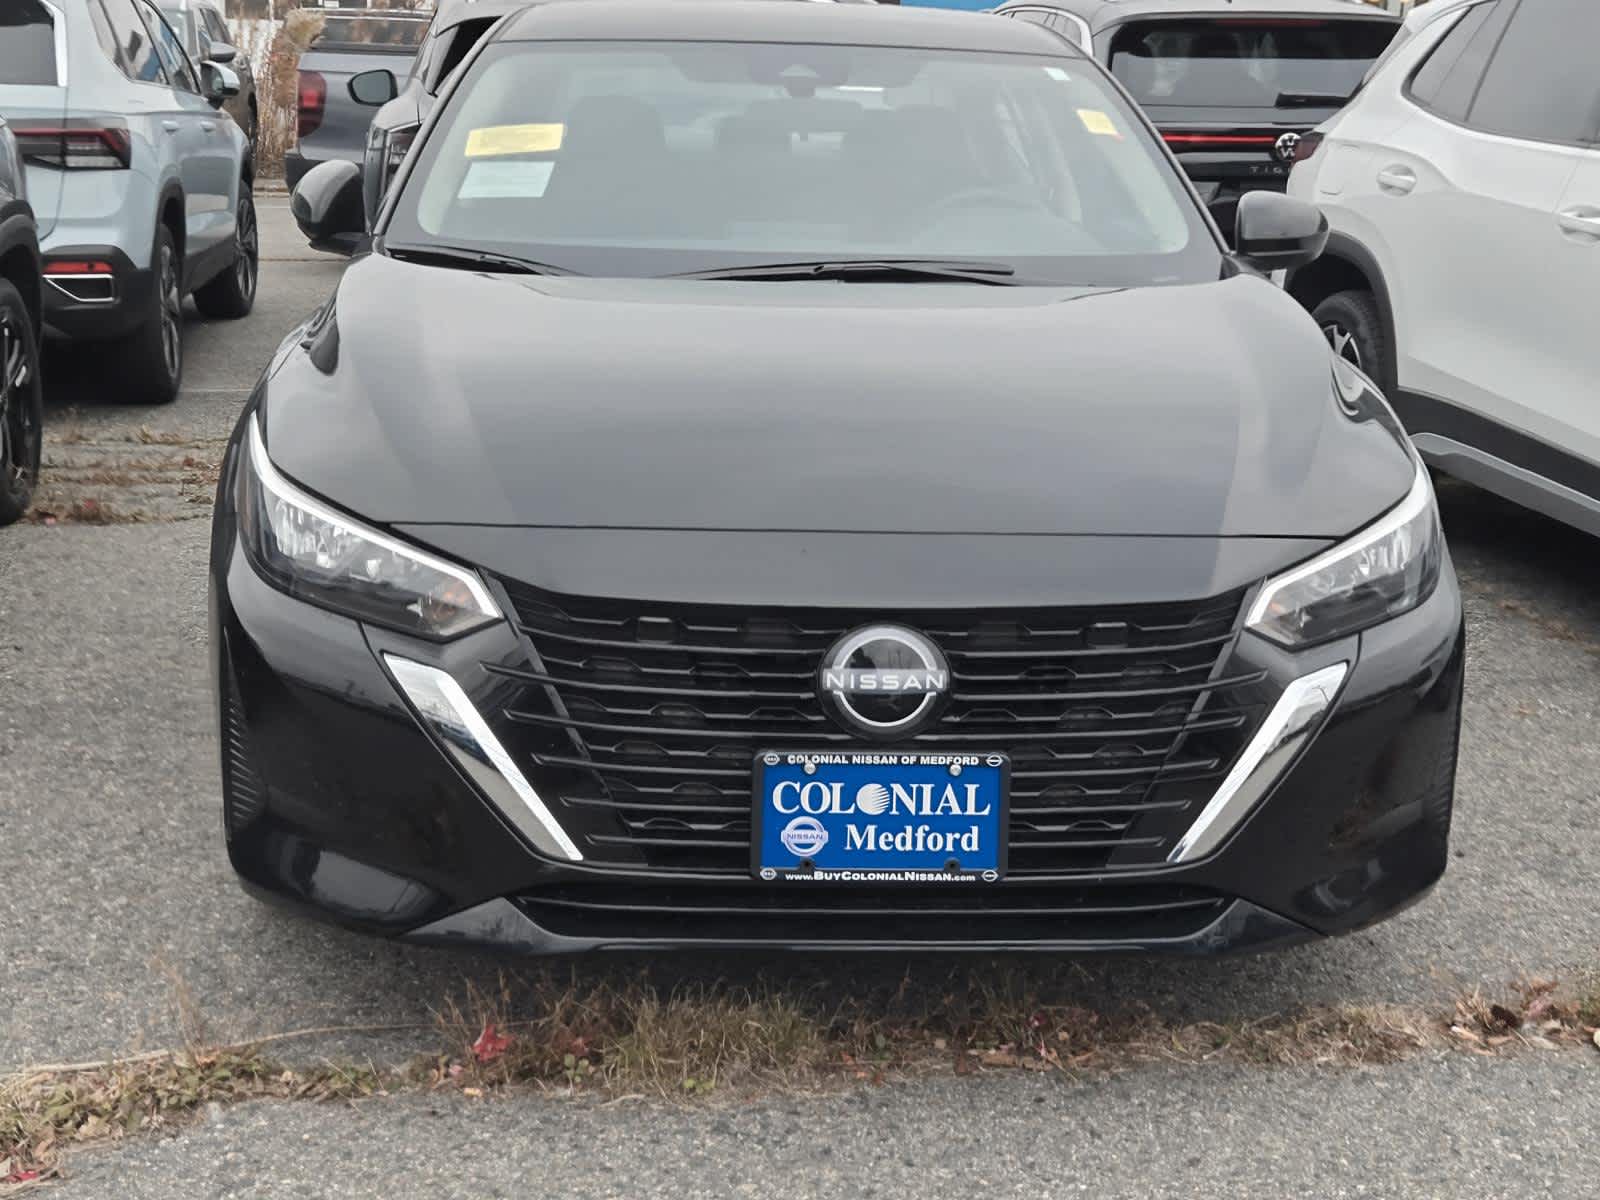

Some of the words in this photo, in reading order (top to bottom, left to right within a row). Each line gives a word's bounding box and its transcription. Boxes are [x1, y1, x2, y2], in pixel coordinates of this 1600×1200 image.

[1250, 166, 1290, 176] TIG
[825, 673, 944, 690] NISSAN
[787, 754, 849, 765] COLONIAL
[852, 755, 898, 765] NISSAN
[901, 756, 917, 765] OF
[920, 756, 980, 766] MEDFORD
[786, 832, 824, 841] NISSAN
[844, 824, 980, 852] Medford
